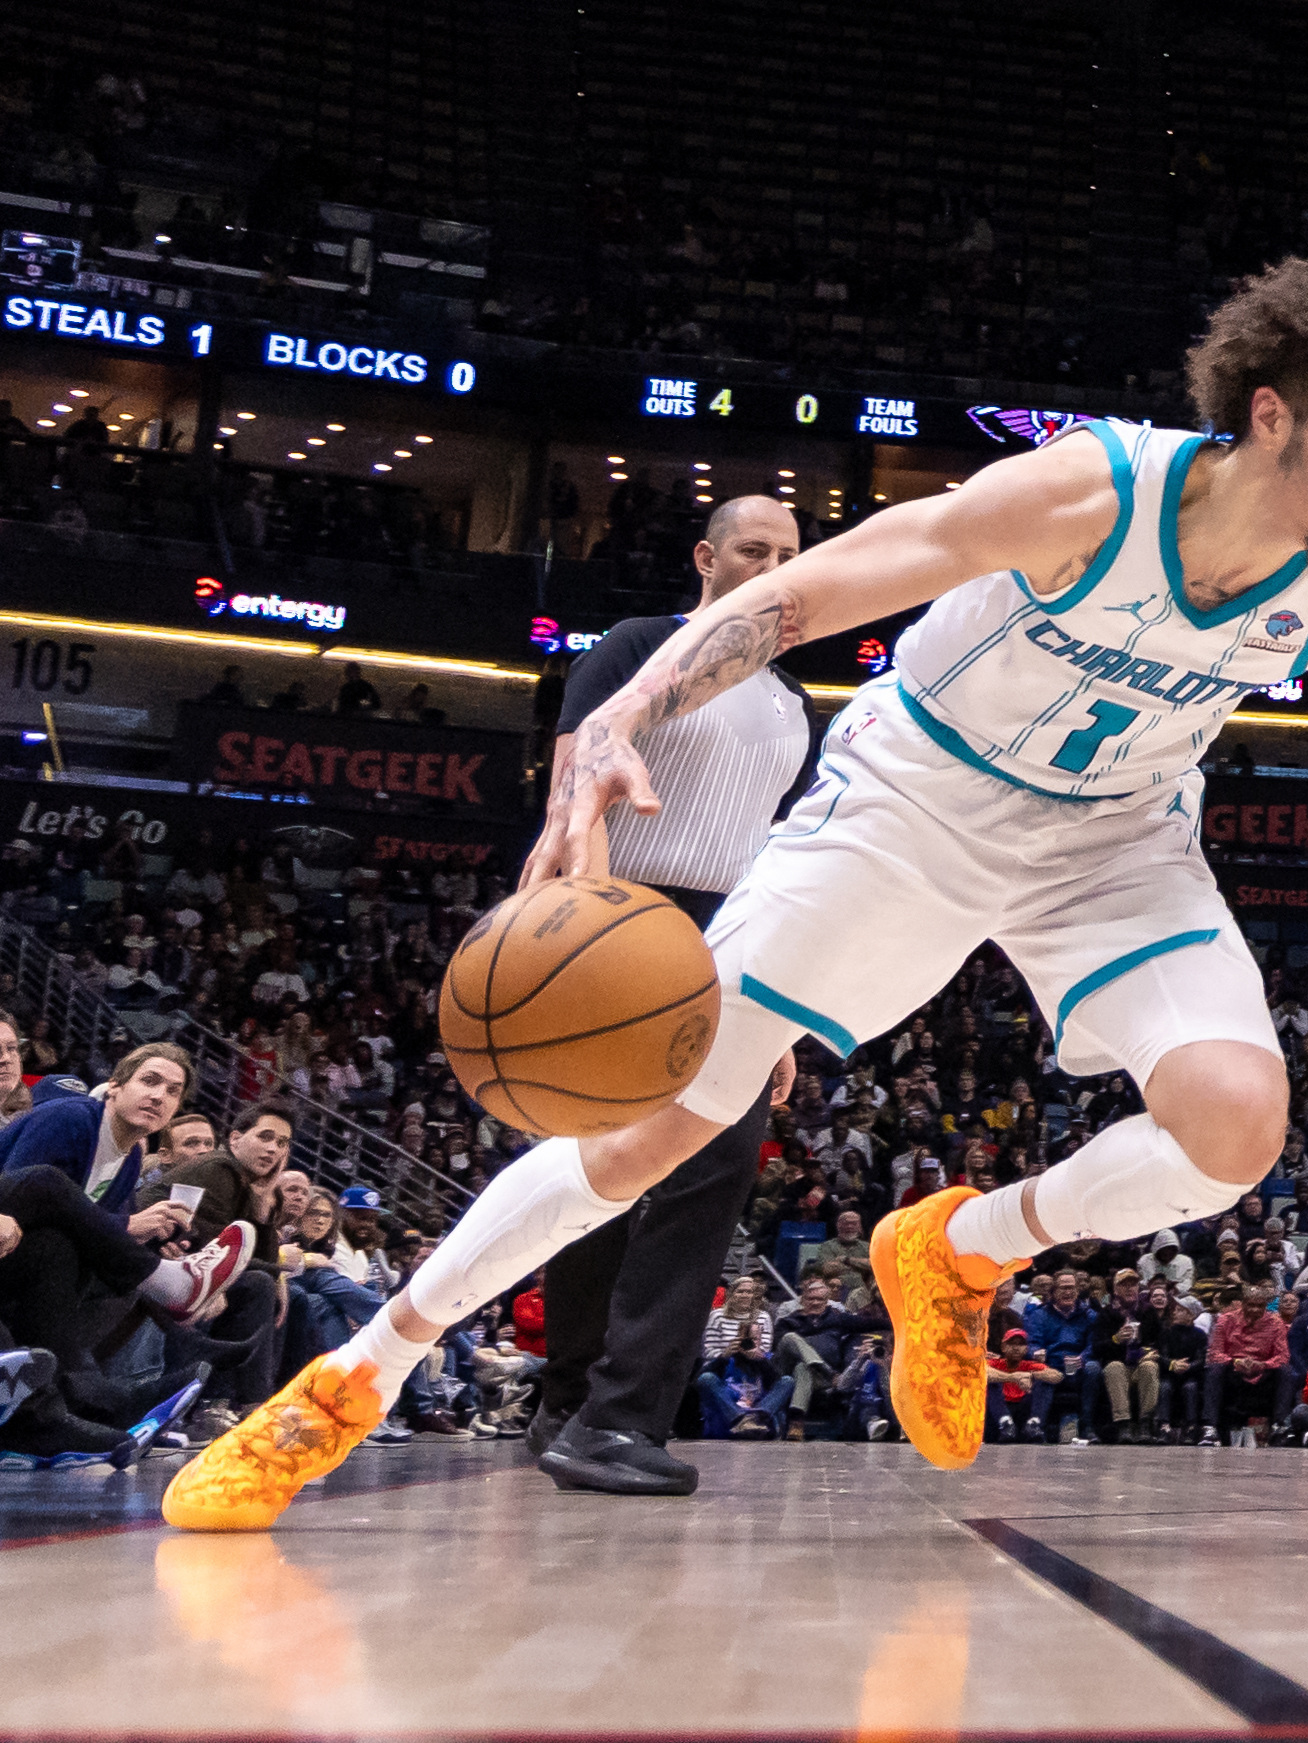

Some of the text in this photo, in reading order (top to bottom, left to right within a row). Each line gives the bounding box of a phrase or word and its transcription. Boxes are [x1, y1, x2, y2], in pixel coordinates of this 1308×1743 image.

[5, 298, 212, 354] STEALS 1
[267, 334, 476, 392] BLOCKS 0
[645, 397, 696, 416] OUTS
[649, 379, 698, 398] TIME
[709, 388, 734, 416] 4
[795, 394, 819, 424] 0
[859, 415, 918, 436] FOULS
[865, 397, 915, 418] TEAM
[230, 593, 346, 630] entergy
[12, 639, 97, 695] 105
[1025, 619, 1264, 704] CHARLOTT
[213, 730, 488, 804] SEATGEEK
[18, 800, 108, 839] Let's
